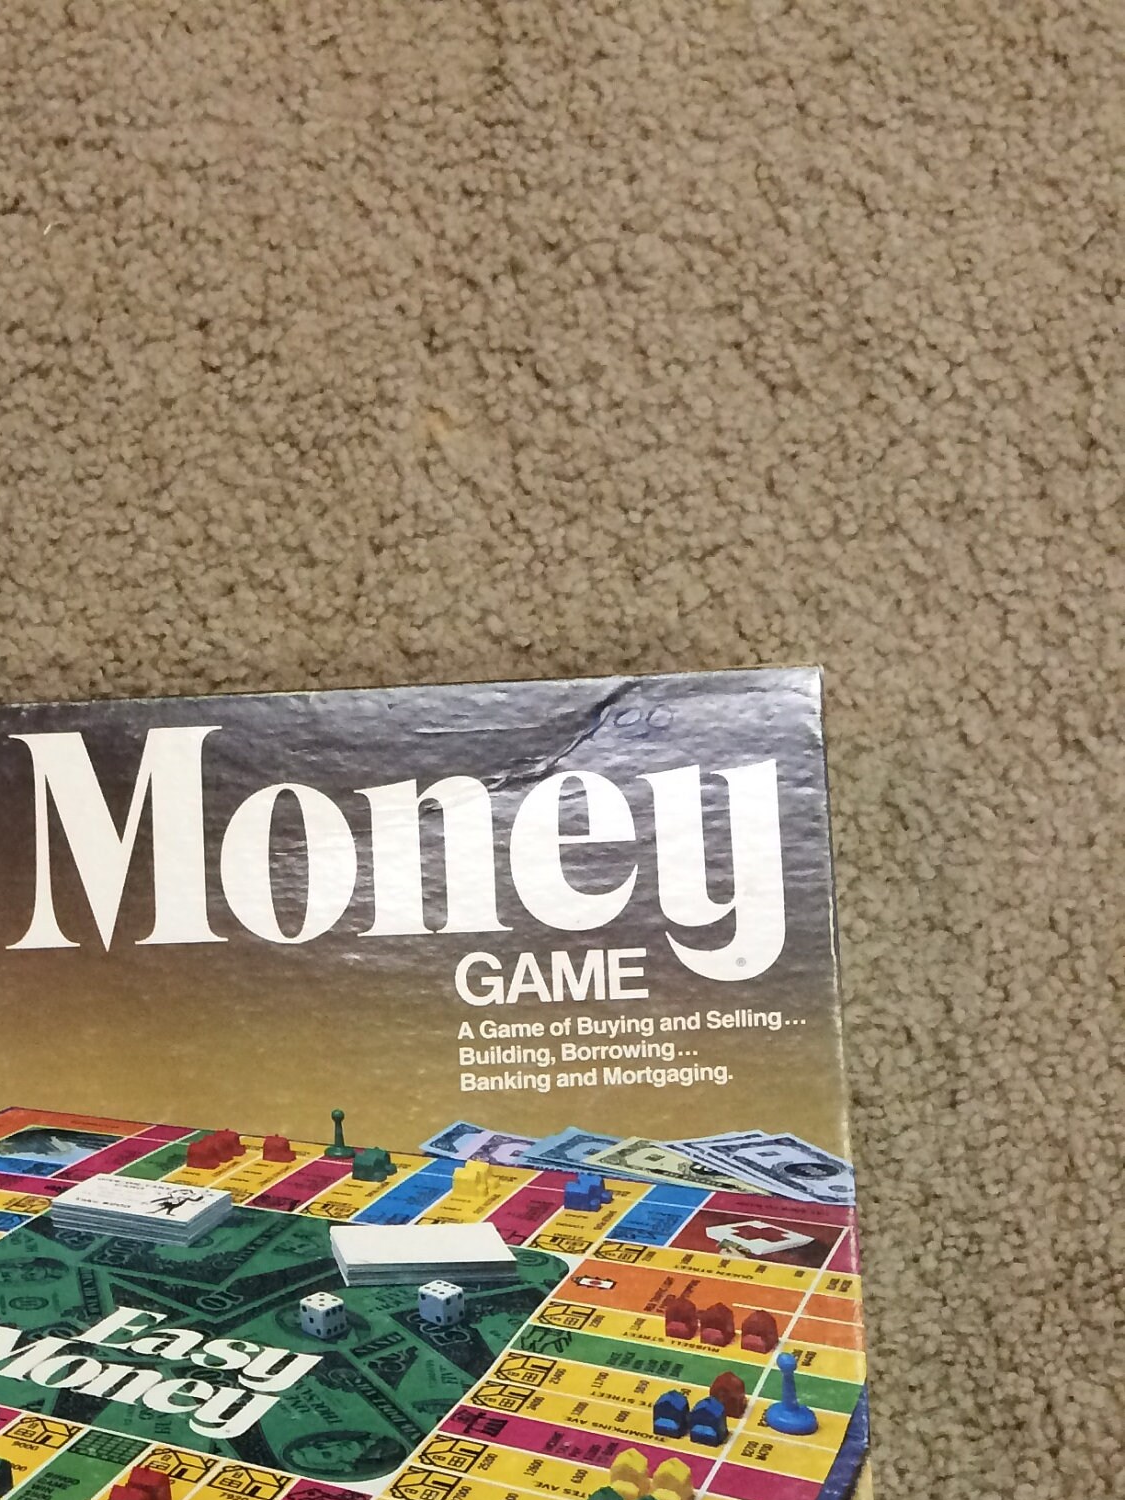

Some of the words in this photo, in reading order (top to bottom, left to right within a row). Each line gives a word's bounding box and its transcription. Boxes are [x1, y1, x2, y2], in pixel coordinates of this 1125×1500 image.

[6, 726, 787, 982] Money
[455, 948, 649, 1006] GAME
[458, 1021, 475, 1039] A
[479, 1020, 545, 1039] Game
[550, 1018, 571, 1036] of
[577, 1015, 654, 1039] Buying
[660, 1011, 700, 1032] and
[459, 1045, 556, 1067] Building,
[460, 1071, 551, 1093] Banking
[557, 1068, 598, 1088] and
[603, 1064, 733, 1087] Mortgaging.
[71, 1306, 324, 1392] Easy
[591, 1421, 666, 1443] THOMPKINS
